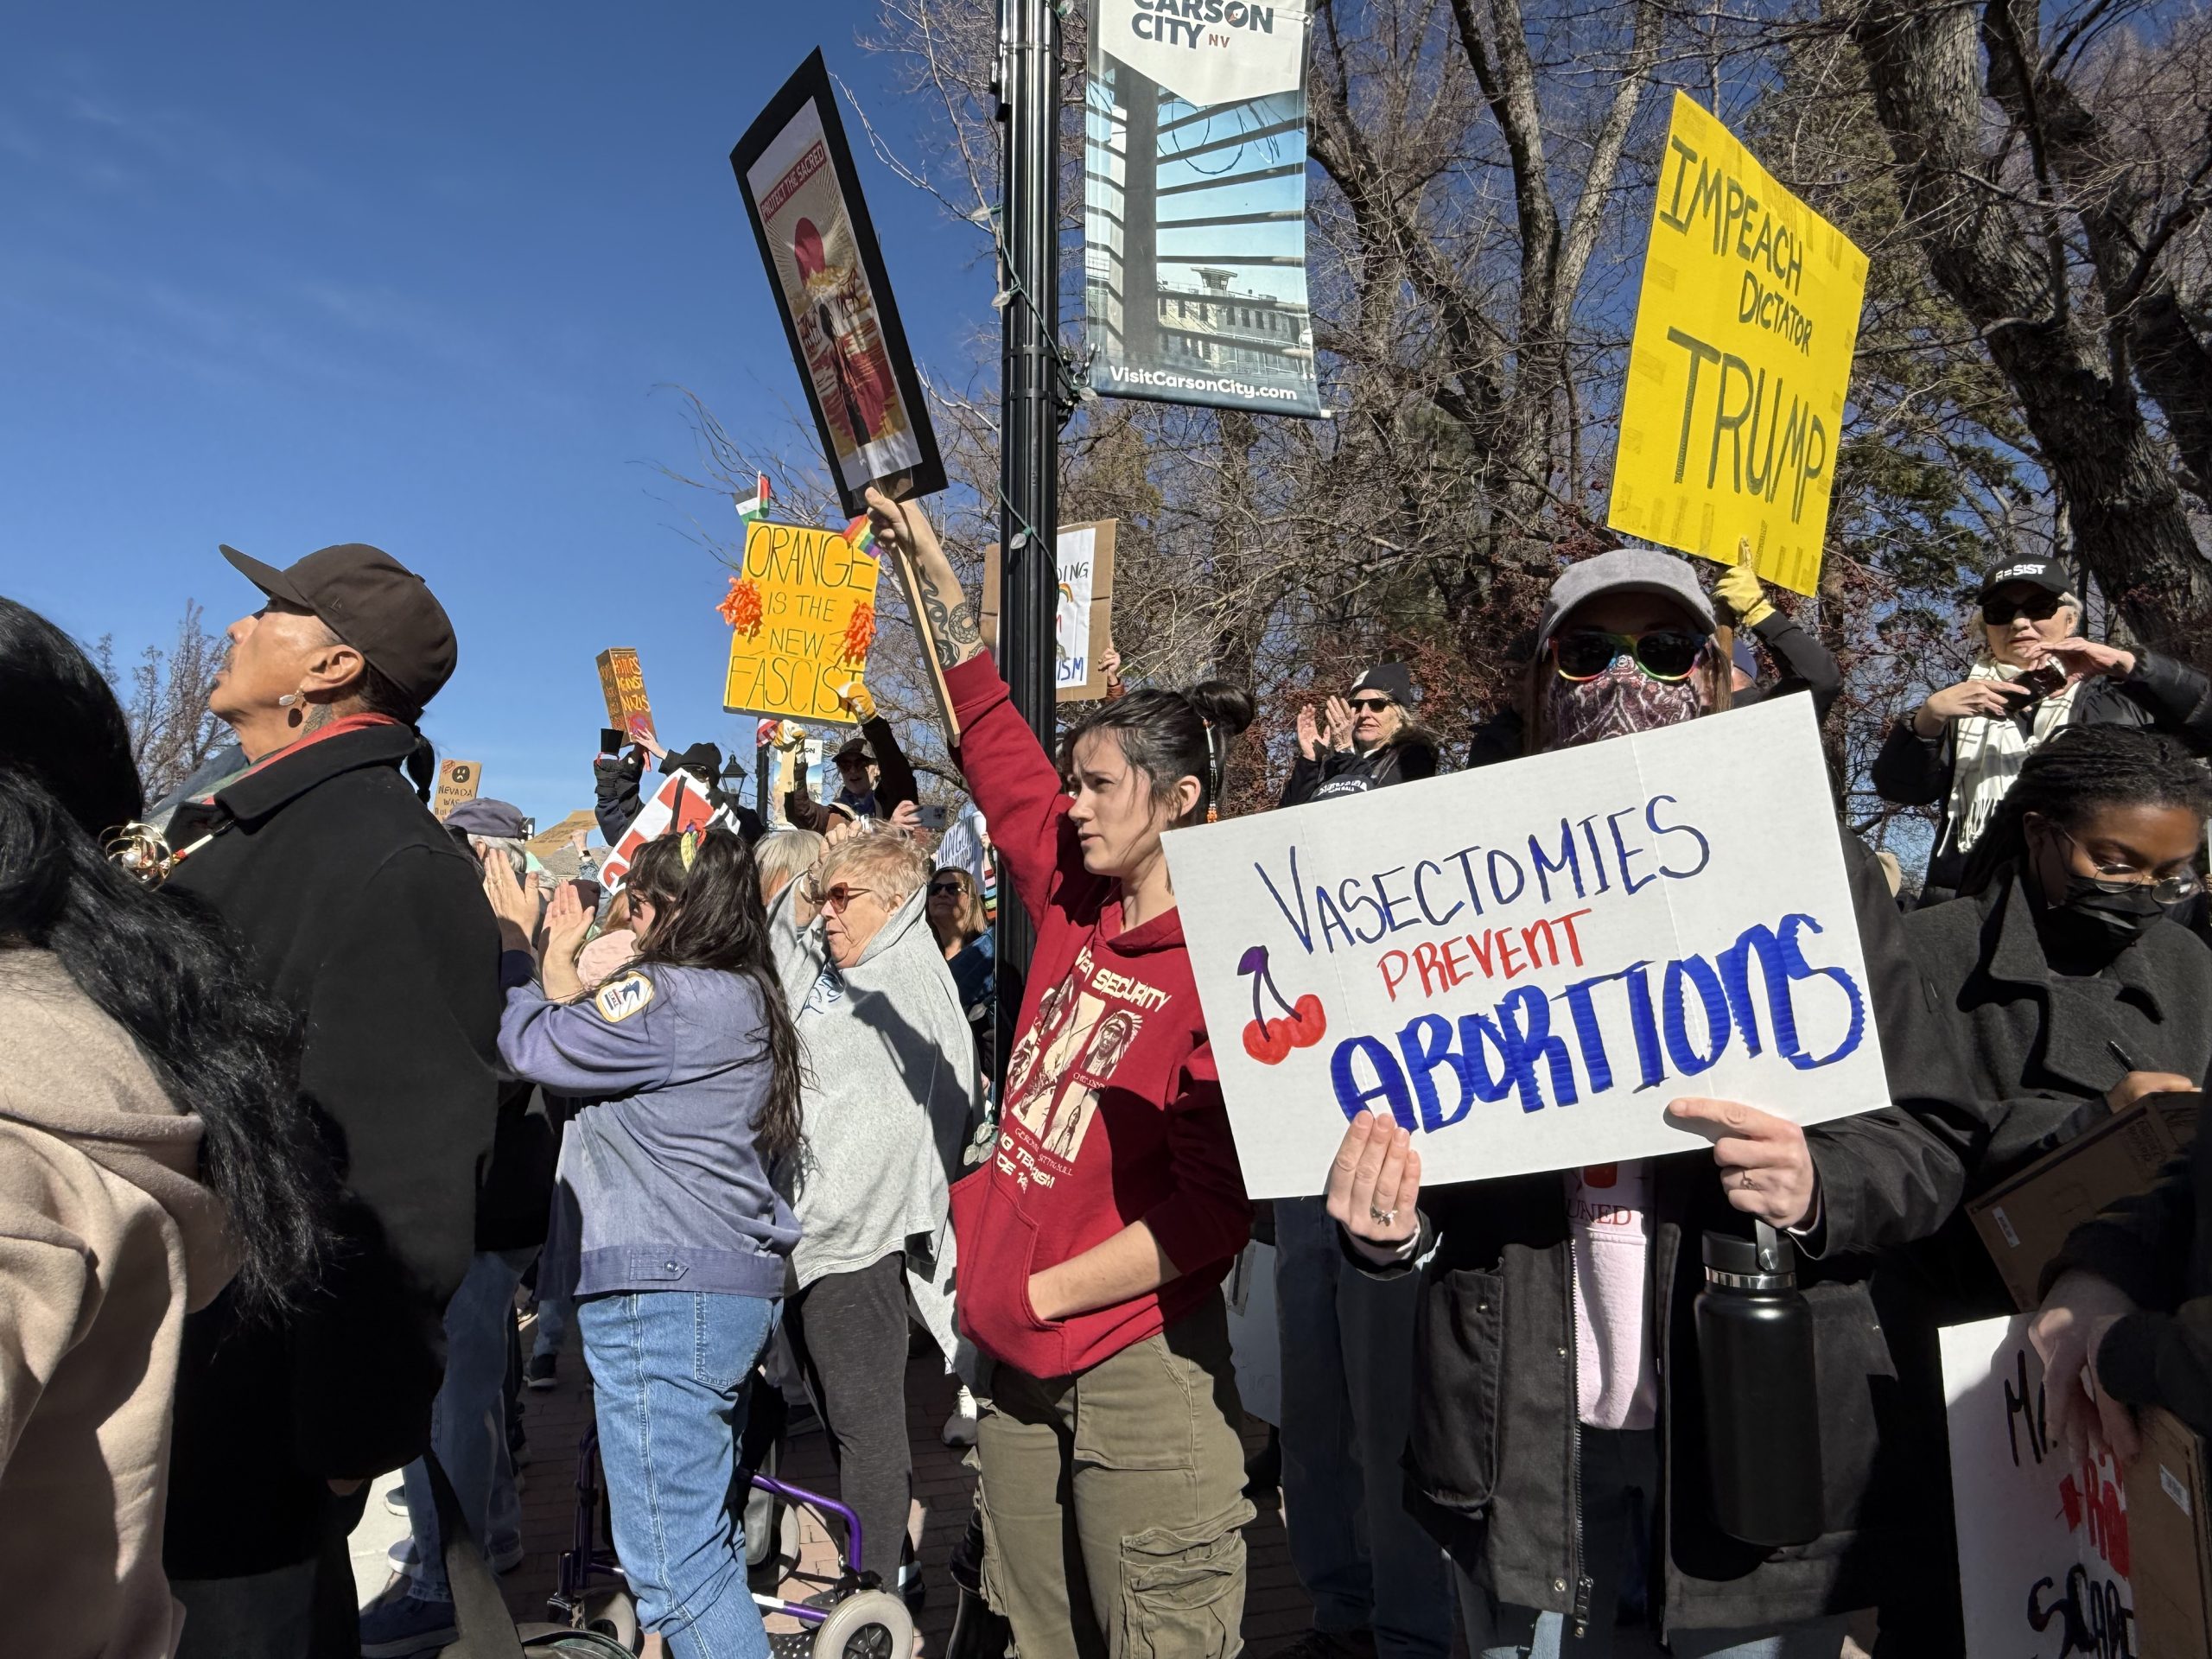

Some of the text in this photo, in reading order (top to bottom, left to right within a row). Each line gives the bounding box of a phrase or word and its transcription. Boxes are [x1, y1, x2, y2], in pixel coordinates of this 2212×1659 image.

[1131, 13, 1231, 49] CITY NV
[760, 181, 787, 216] PROTECT
[796, 144, 824, 181] SACRED
[1658, 134, 1804, 297] IMPEACH
[1738, 270, 1814, 358] DICTATOR
[1109, 365, 1298, 402] VisitCarsonCity.com
[1666, 325, 1827, 525] TRUMP
[747, 524, 874, 593] ORANGE
[1995, 563, 2047, 582] RESIST
[767, 593, 837, 622] IS THE
[769, 628, 825, 659] NEW
[621, 694, 651, 712] NAZIS
[726, 655, 865, 719] FASCIST
[438, 785, 473, 797] NEVADA
[1254, 795, 1711, 955] VASECTOMIES
[1376, 908, 1592, 1002] PREVENT
[1091, 968, 1172, 1012] SECURITY
[1329, 912, 1866, 1135] ABORTIONS
[1567, 1198, 1631, 1225] UNED
